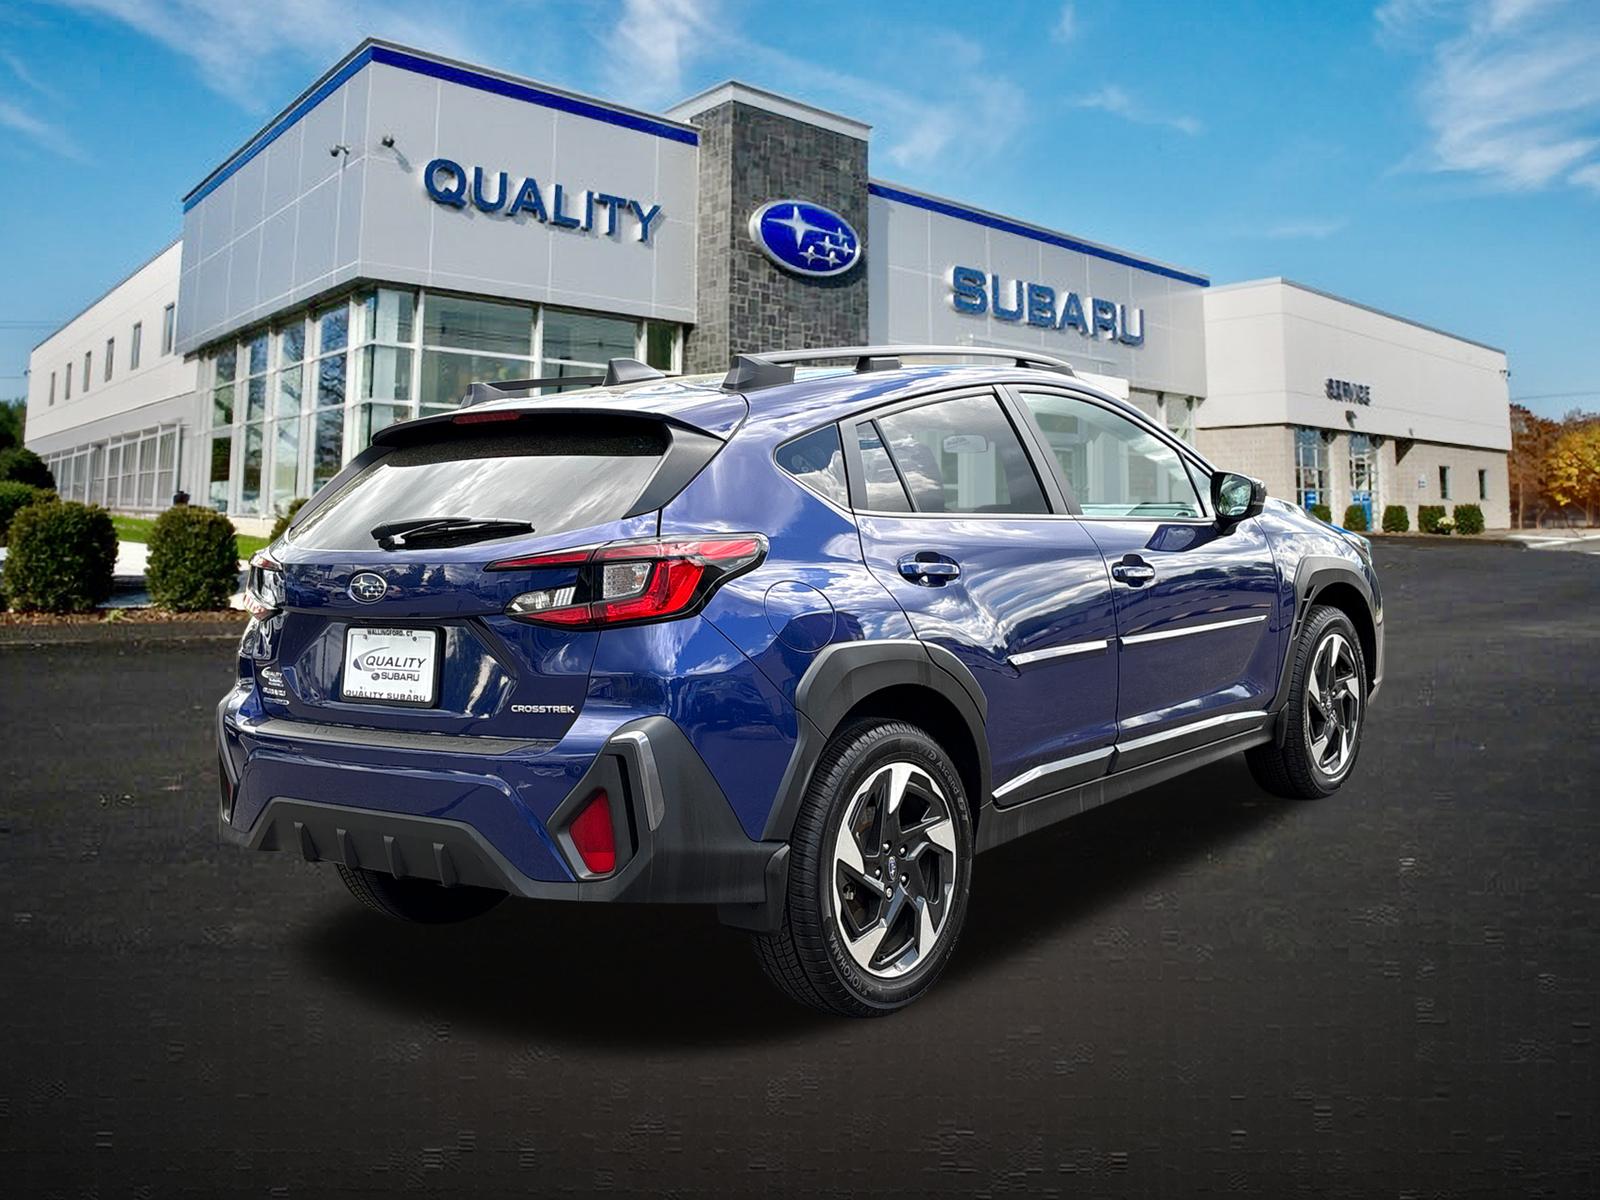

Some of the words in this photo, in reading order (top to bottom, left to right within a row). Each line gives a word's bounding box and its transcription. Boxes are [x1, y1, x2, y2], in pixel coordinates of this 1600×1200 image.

[424, 158, 662, 243] QUALITY
[948, 265, 1144, 346] SUBARU
[365, 655, 427, 668] QUALITY
[381, 671, 420, 681] SUBARU
[345, 689, 383, 698] QUALITY
[386, 691, 426, 702] SUBARU
[511, 704, 575, 714] CROSSTREK
